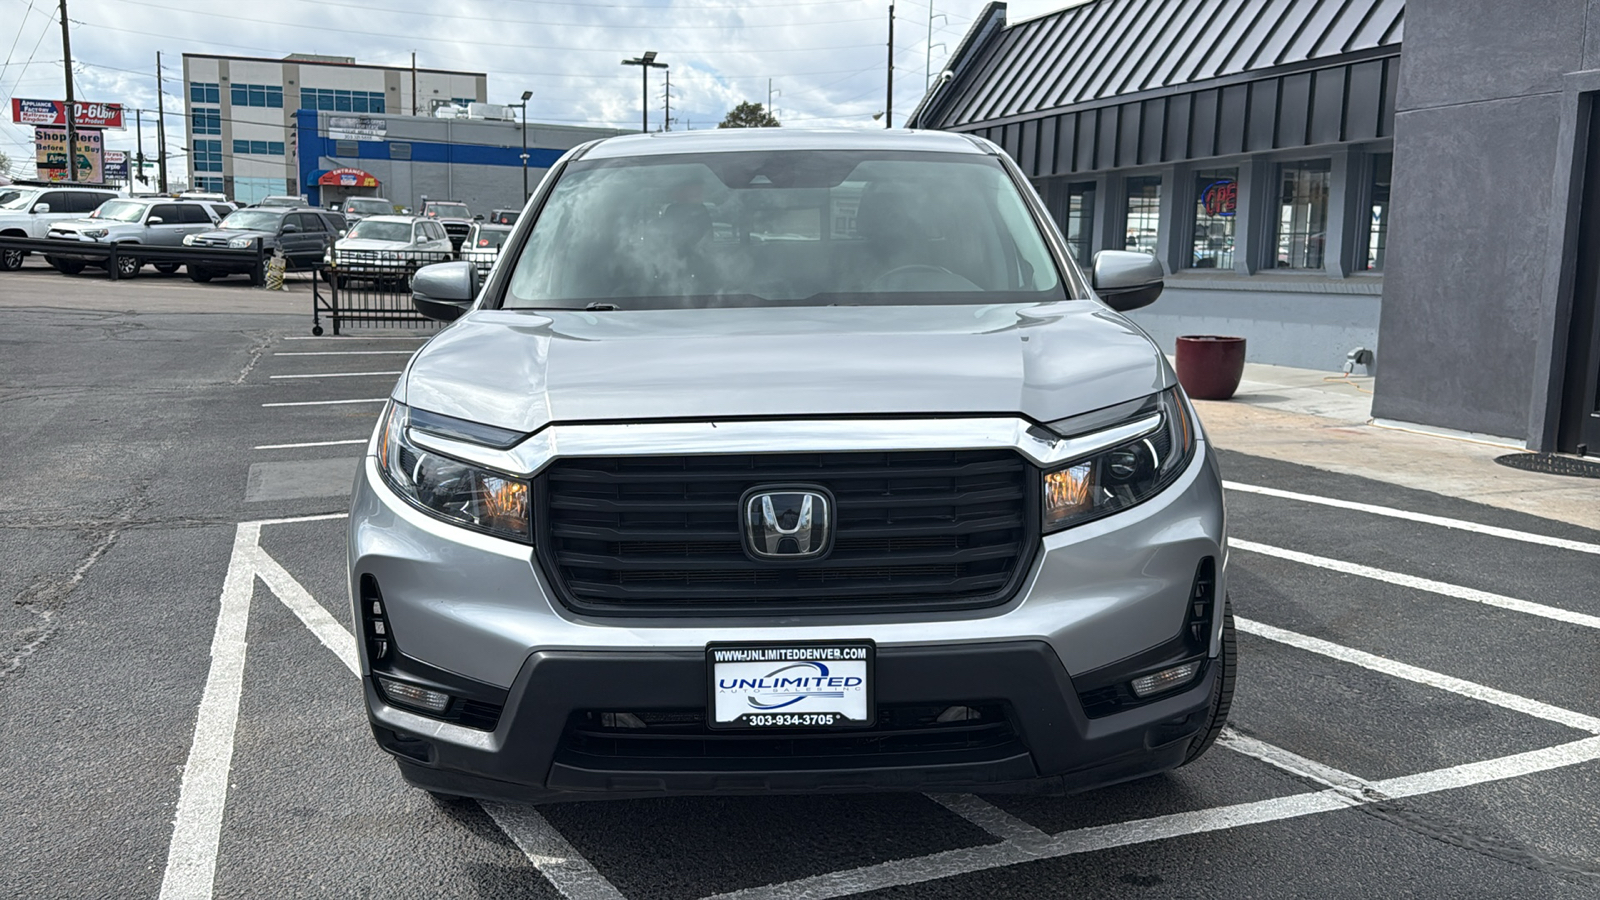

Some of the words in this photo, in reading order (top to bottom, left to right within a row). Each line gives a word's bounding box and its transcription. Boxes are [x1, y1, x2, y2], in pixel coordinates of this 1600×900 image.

[35, 130, 66, 142] Shop
[36, 143, 64, 151] Before
[84, 145, 100, 153] Buy
[332, 168, 365, 177] ENTRANCE
[1206, 180, 1238, 217] OPE
[719, 677, 863, 689] UNLIMITED
[749, 714, 834, 726] 303-934-3705
